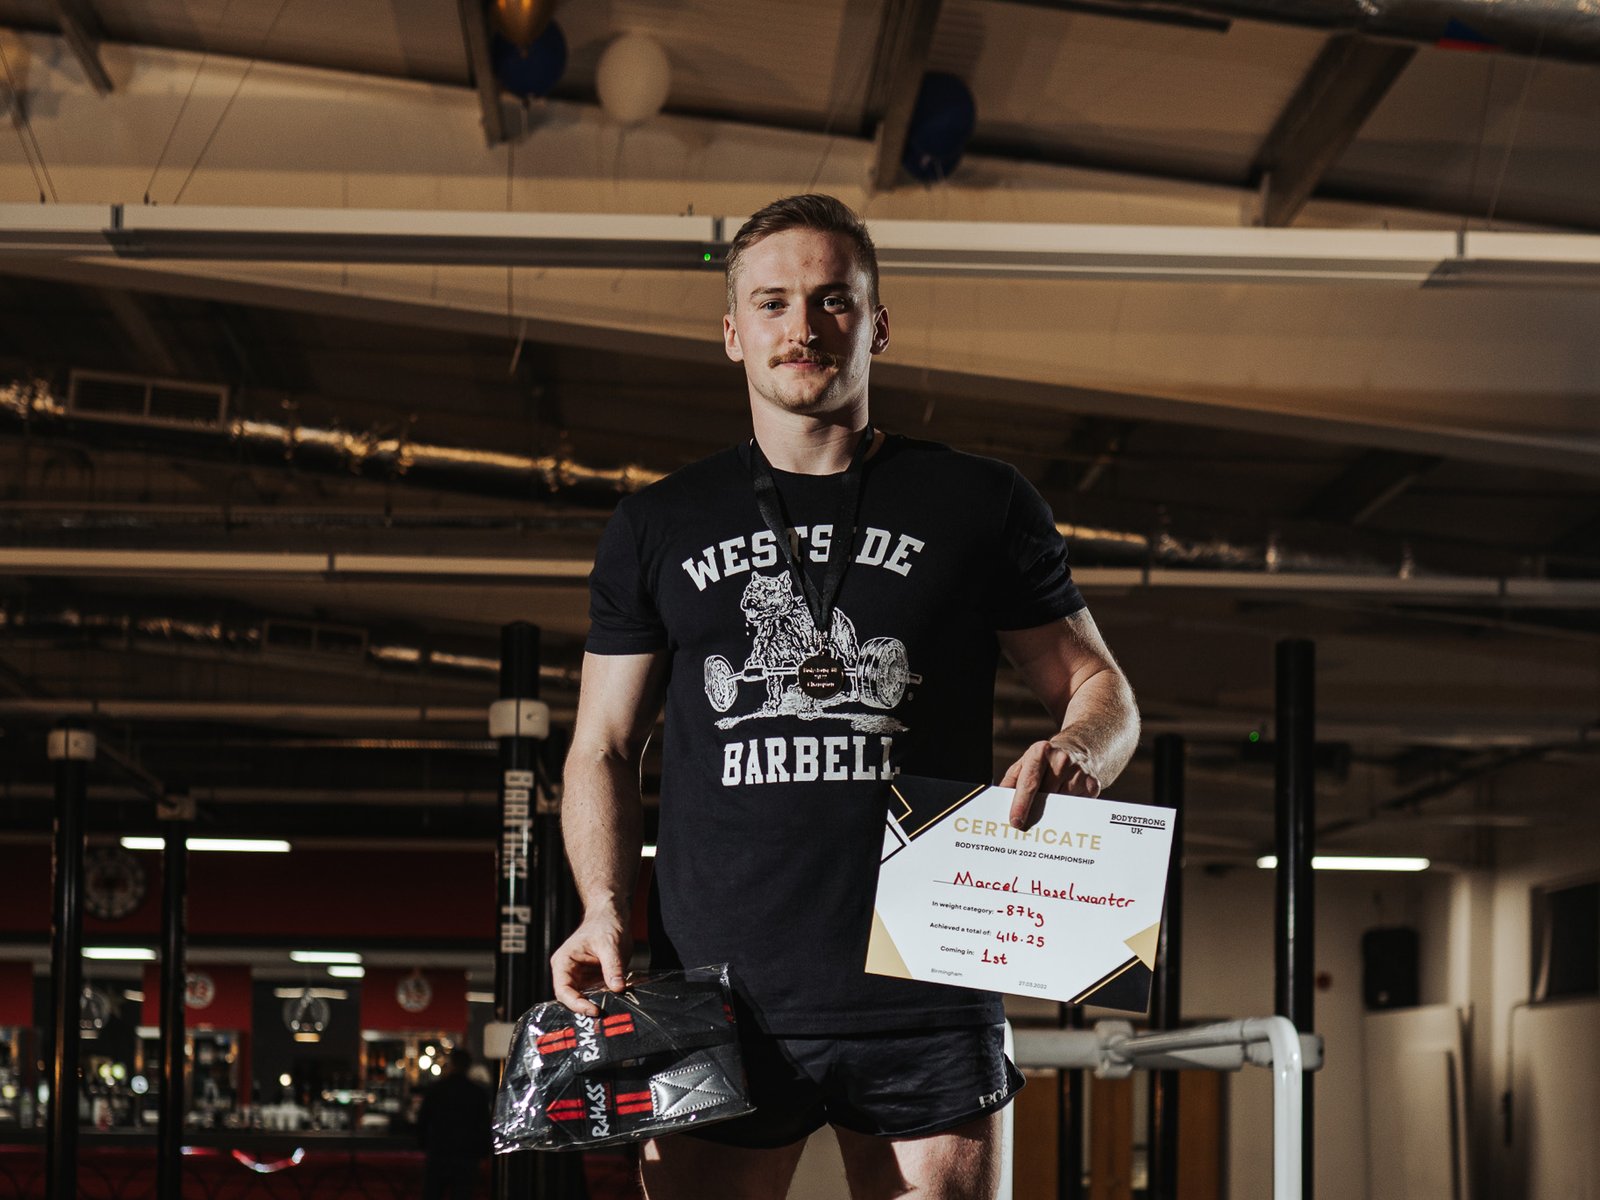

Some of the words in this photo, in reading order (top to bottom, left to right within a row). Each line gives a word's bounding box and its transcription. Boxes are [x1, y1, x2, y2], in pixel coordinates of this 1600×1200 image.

[682, 524, 925, 591] WESTSDE
[721, 736, 901, 786] BARBELL
[1111, 813, 1166, 827] BODYSTRONG
[954, 817, 1102, 851] CERTIFICATE
[1131, 827, 1143, 835] UK
[955, 841, 1006, 854] BODYSTRONG
[1007, 848, 1018, 856] UK
[1019, 849, 1037, 859] 2022
[1038, 852, 1095, 865] CHAMPIONSHIP
[953, 871, 1018, 893] Marcel
[940, 902, 962, 911] weight
[962, 904, 994, 915] category:
[930, 922, 960, 932] Achieved
[966, 927, 982, 935] total
[996, 930, 1045, 948] 416.25
[940, 945, 966, 955] Coming
[981, 948, 1008, 965] 1st
